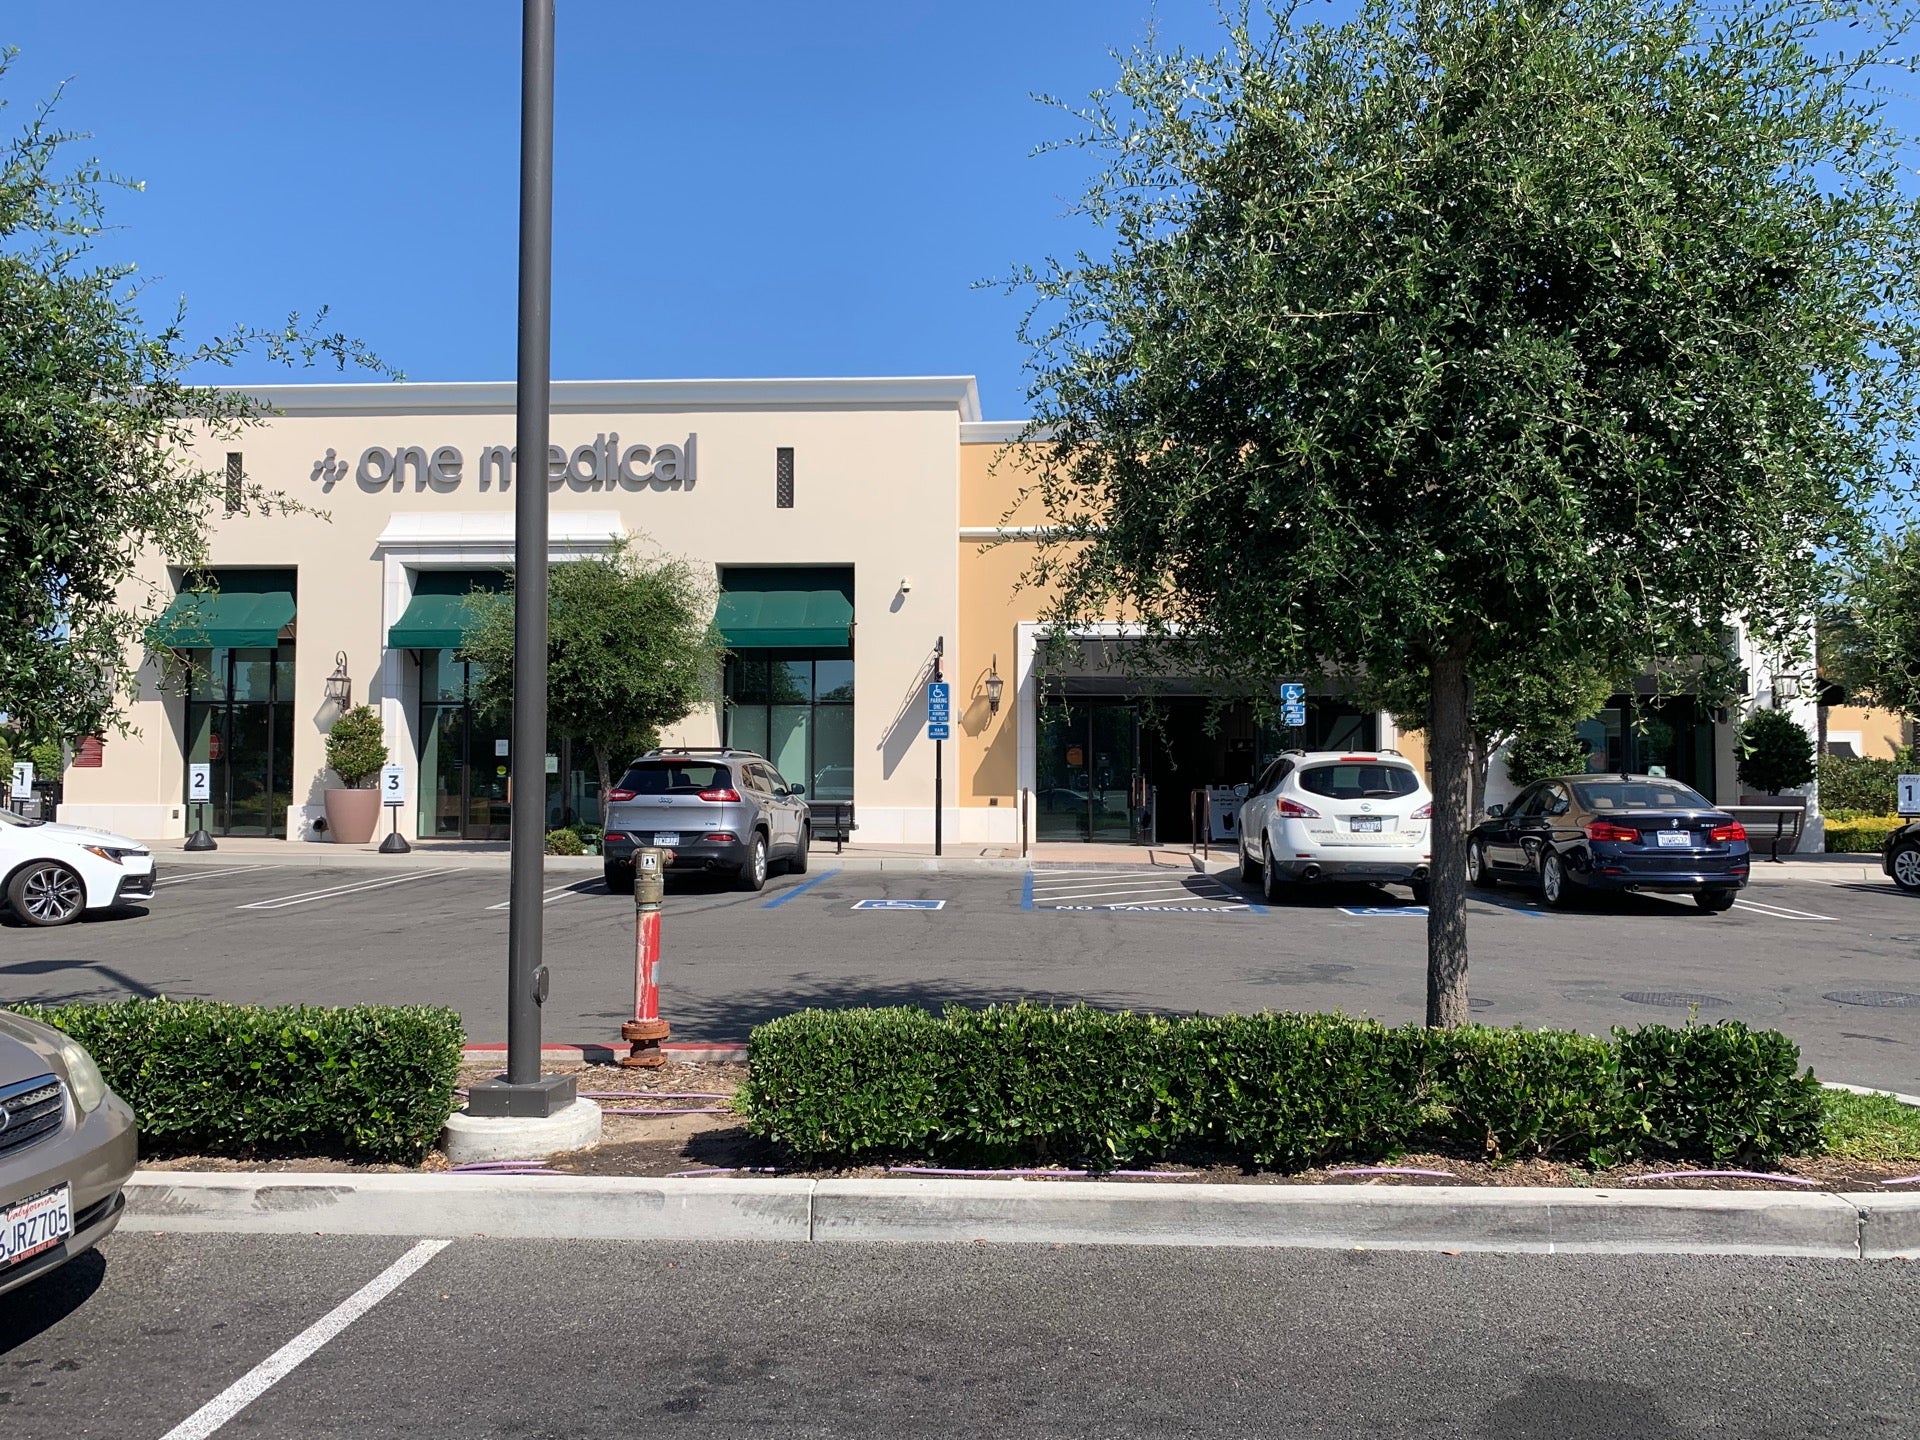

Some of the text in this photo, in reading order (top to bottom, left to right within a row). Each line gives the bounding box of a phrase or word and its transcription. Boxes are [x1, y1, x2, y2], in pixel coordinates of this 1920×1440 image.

[358, 431, 698, 484] one medical
[18, 771, 25, 787] 1
[194, 772, 205, 788] 2
[388, 775, 400, 790] 3
[1905, 785, 1913, 802] 1
[1110, 905, 1235, 913] PARKING
[6, 1196, 57, 1222] California
